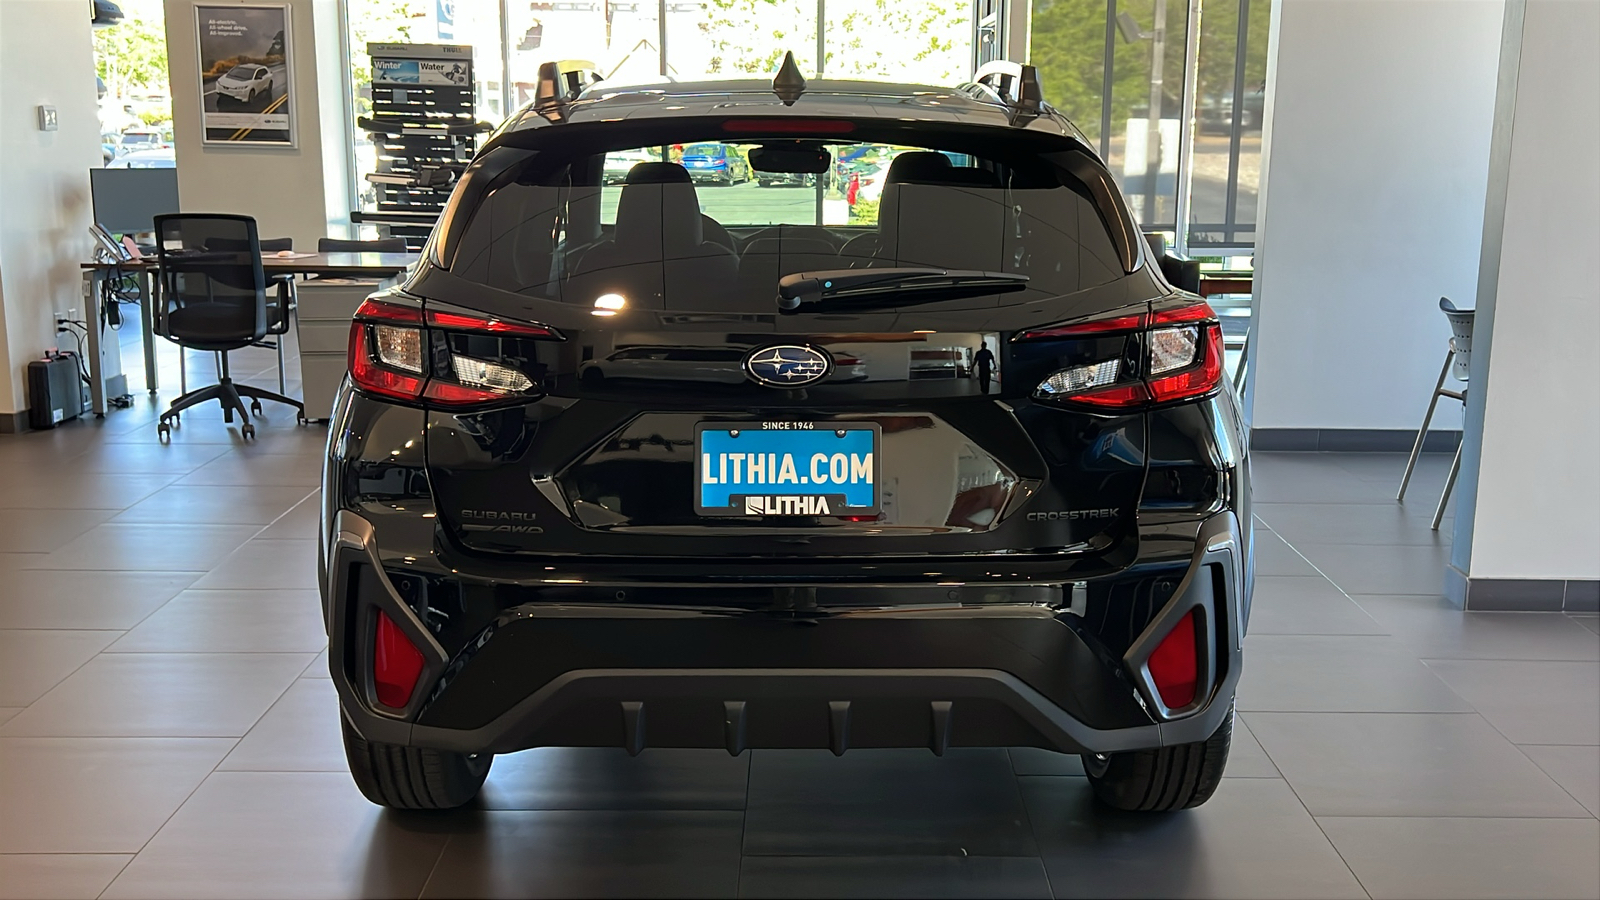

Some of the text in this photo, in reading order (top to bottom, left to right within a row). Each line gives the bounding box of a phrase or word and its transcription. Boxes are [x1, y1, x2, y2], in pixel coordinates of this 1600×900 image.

[373, 61, 402, 70] Winter
[420, 63, 445, 71] Water
[762, 421, 814, 430] SINCE 1946
[702, 452, 874, 485] LITHIA.COM
[764, 496, 830, 515] LITHIA
[461, 509, 537, 521] SUBARU
[1026, 507, 1120, 521] CROSSTREK
[492, 524, 544, 534] AWD
